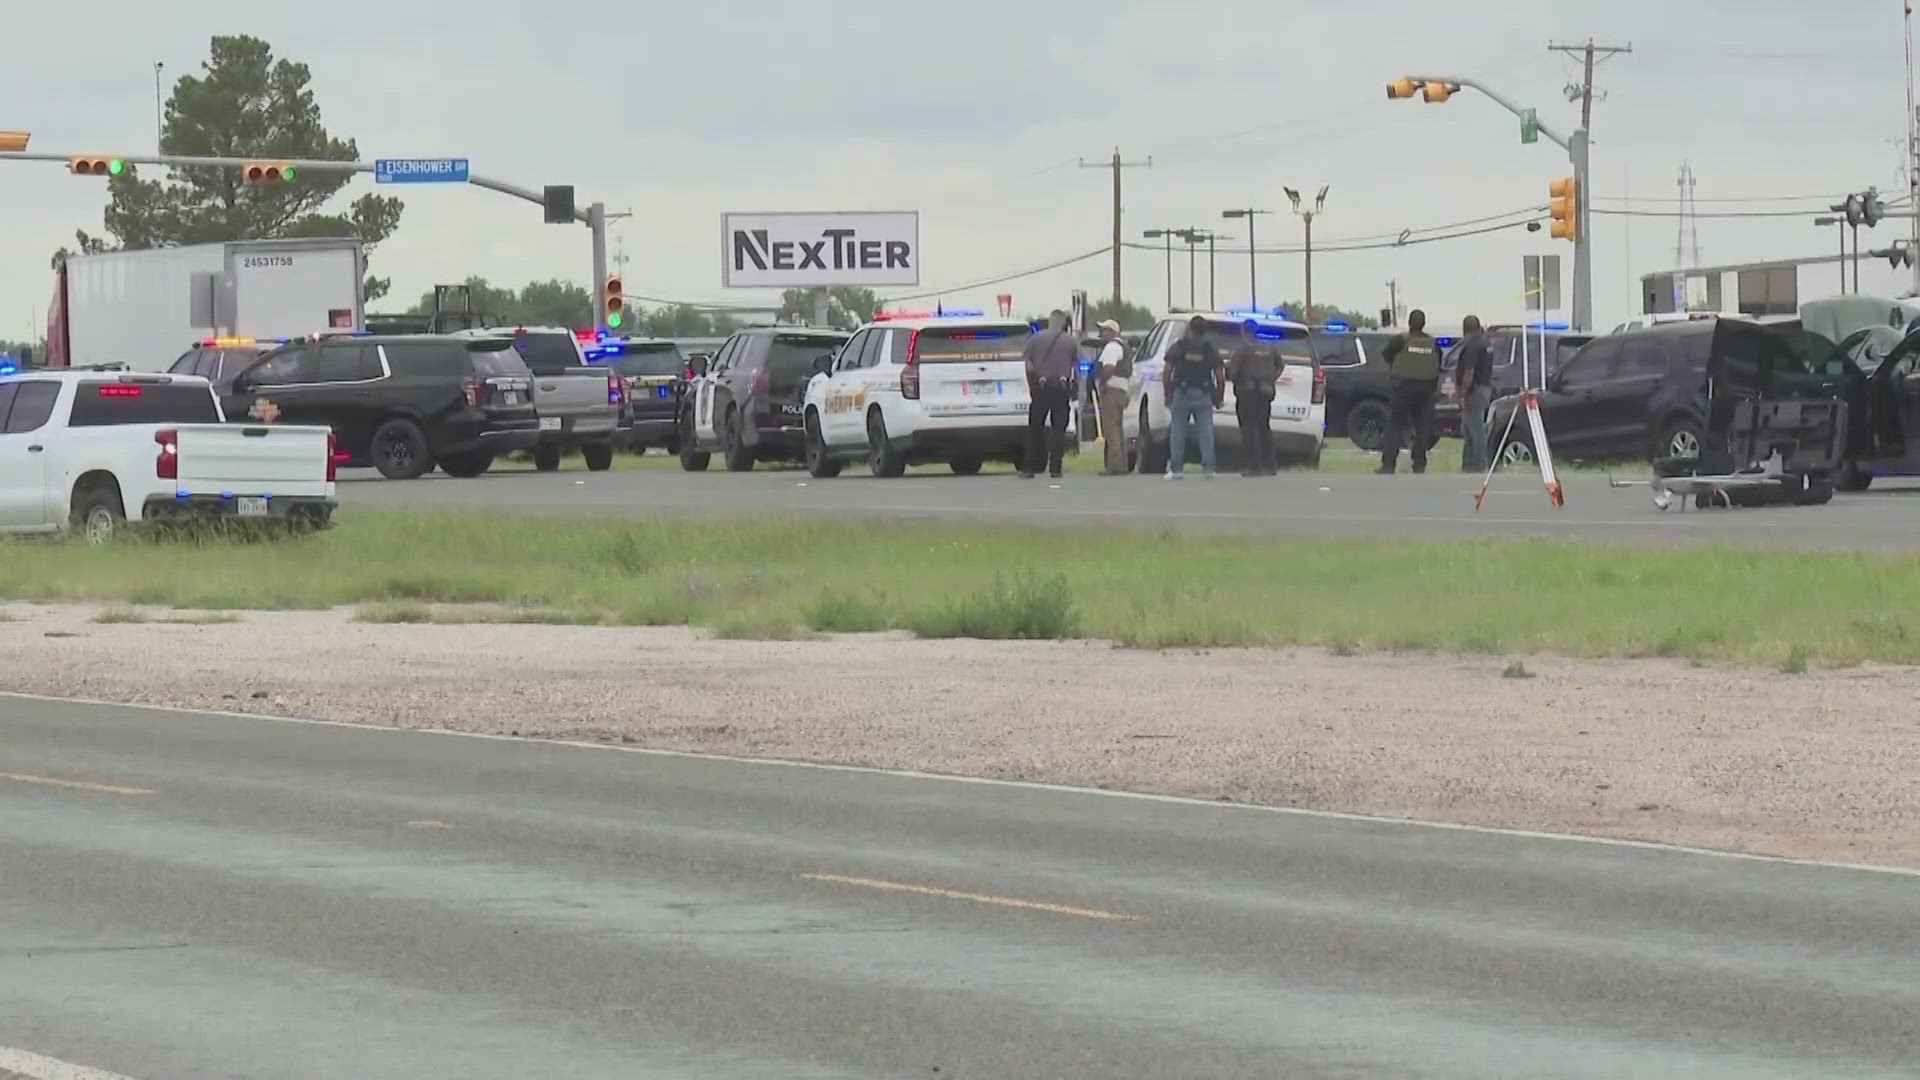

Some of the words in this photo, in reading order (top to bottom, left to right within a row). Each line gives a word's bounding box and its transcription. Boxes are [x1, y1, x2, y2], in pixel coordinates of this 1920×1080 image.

[386, 161, 452, 174] EISENHOWER
[455, 161, 467, 172] DR
[244, 256, 293, 268] 24531758
[962, 352, 999, 361] SHERIFF
[782, 404, 805, 415] POLI
